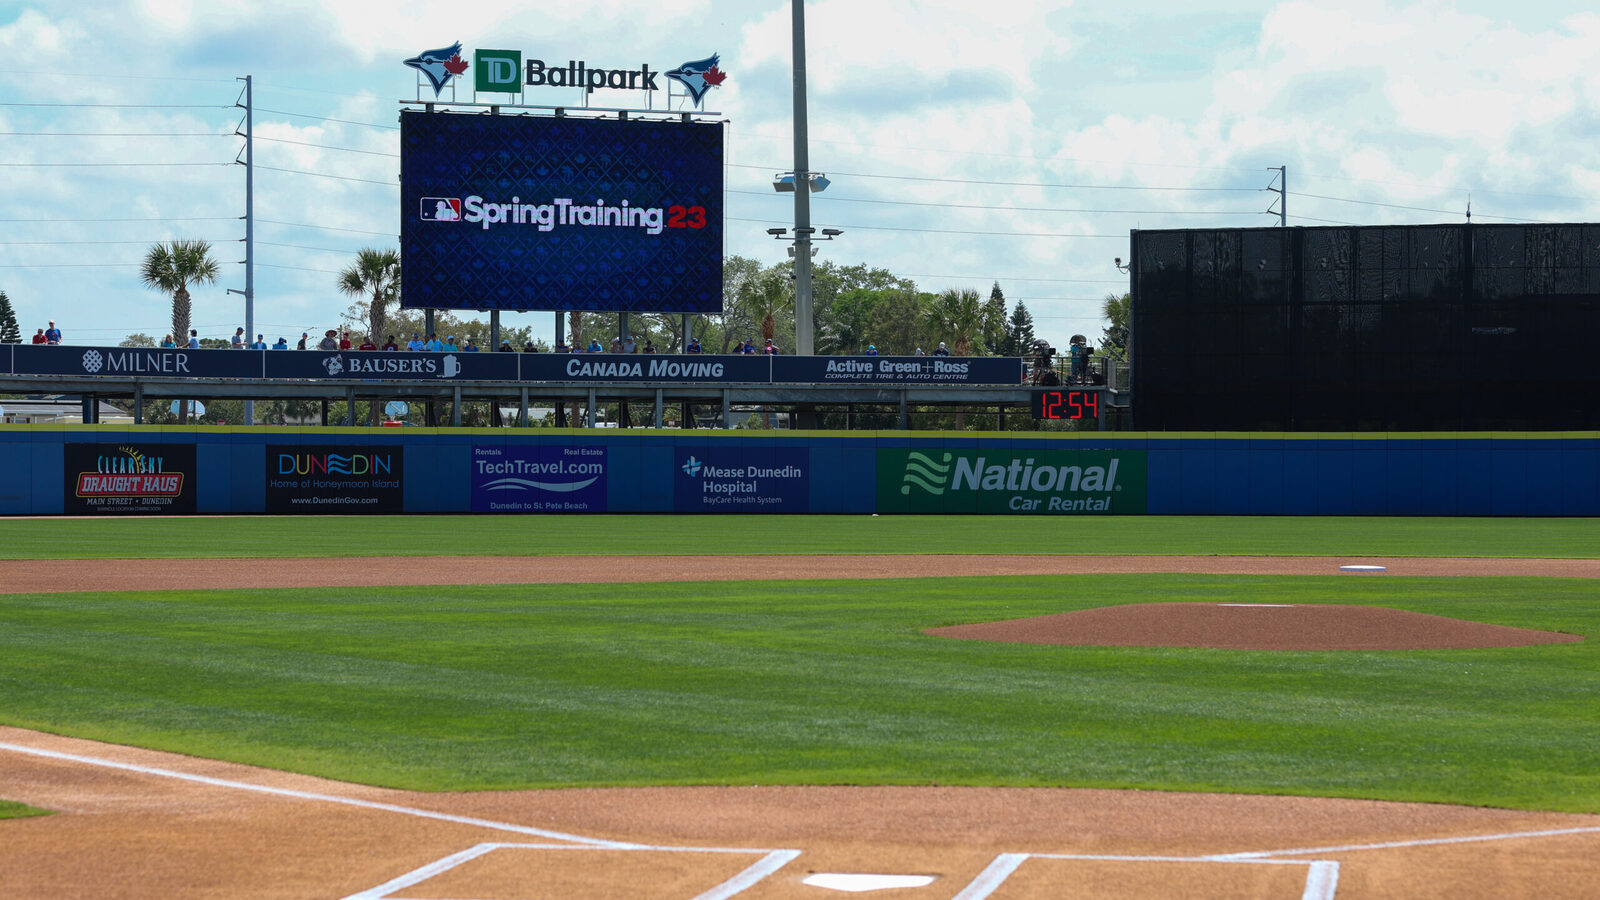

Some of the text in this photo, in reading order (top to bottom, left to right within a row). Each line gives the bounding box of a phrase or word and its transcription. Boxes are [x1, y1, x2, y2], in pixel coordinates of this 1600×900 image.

[480, 56, 659, 93] TD Ballpark
[464, 195, 707, 235] SpringTraining 23
[107, 352, 190, 373] MILNER
[349, 358, 437, 373] BAUSER'S
[566, 358, 724, 378] CANADA MOVING
[826, 360, 873, 373] Active
[1042, 392, 1097, 419] 12:54
[475, 448, 502, 456] Rentals
[97, 455, 164, 474] CLEAR SKY
[279, 453, 391, 475] DUNEDIN
[475, 460, 603, 474] TechTravel.com
[703, 465, 801, 478] Mease Dunedin
[951, 456, 1119, 492] National
[81, 476, 179, 492] DRAUGHT HAUS
[270, 480, 400, 490] Home of Honeymoon Island
[703, 480, 757, 496] Hospital
[291, 497, 378, 505] www.DunedinGov.com
[490, 502, 523, 510] Dunedin
[533, 502, 543, 510] St.
[564, 502, 588, 510] Beach
[703, 496, 782, 505] BayCare Health System
[1008, 496, 1111, 511] Car Rental
